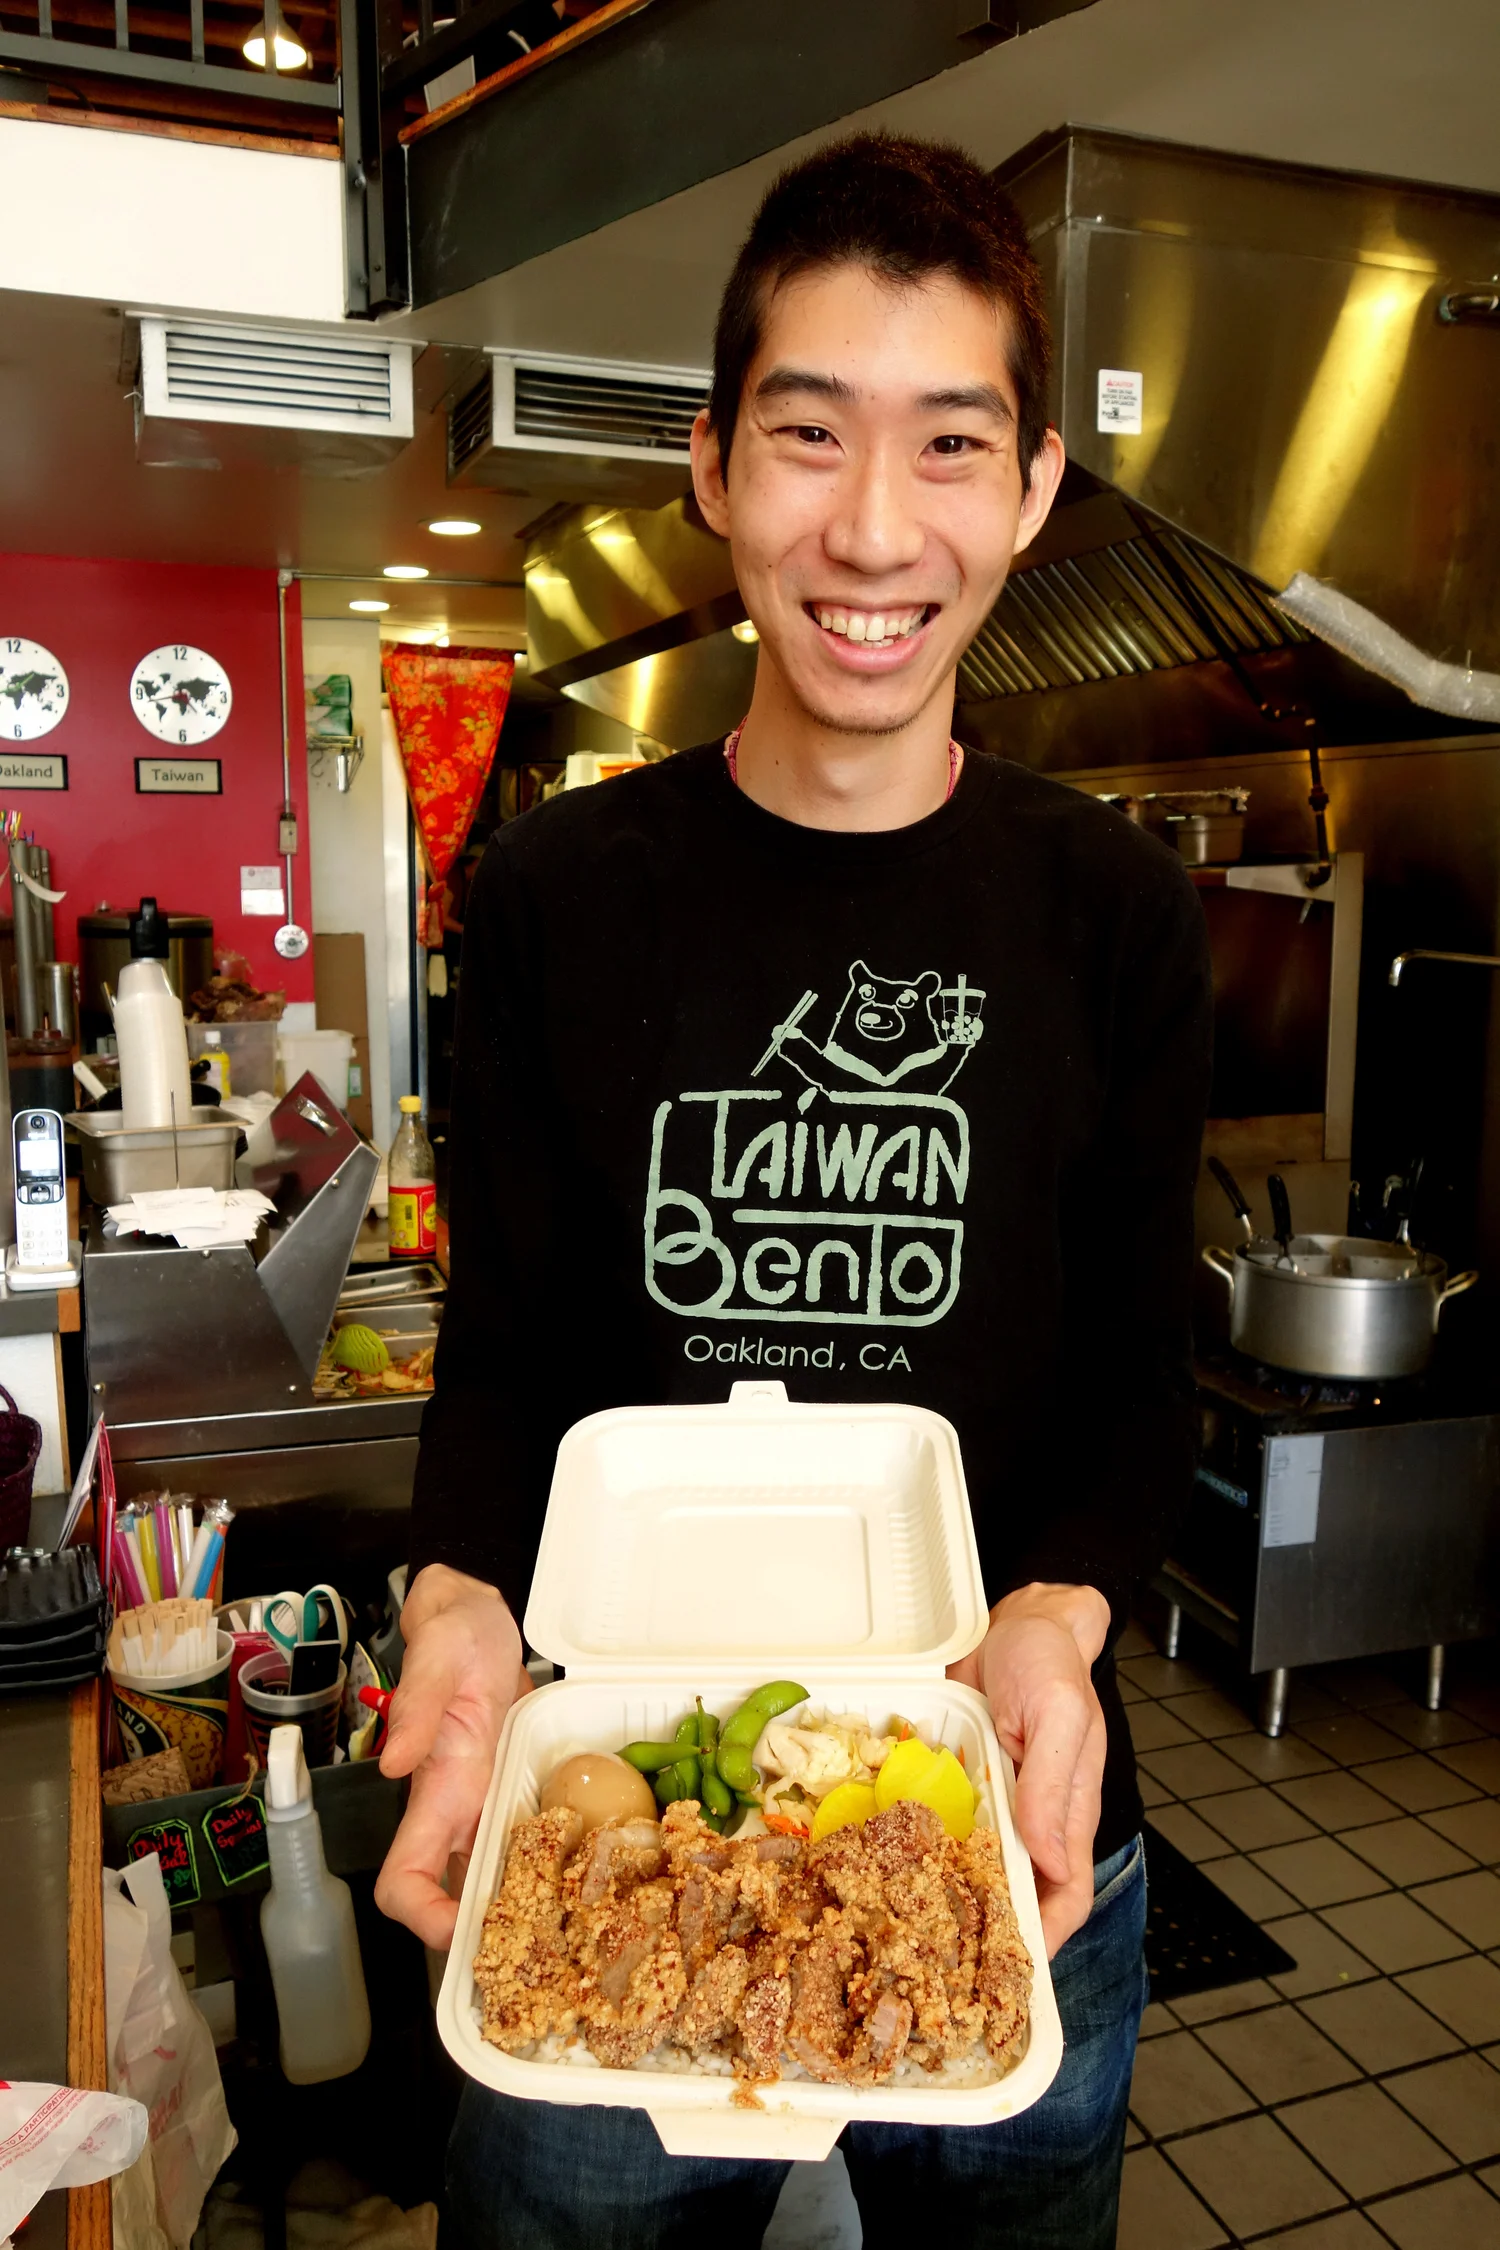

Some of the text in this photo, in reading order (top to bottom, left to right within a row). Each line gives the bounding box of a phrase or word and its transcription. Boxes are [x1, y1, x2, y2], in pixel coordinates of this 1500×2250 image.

[6, 639, 22, 653] 12
[172, 647, 187, 661] 12
[56, 684, 65, 698] 3
[135, 687, 144, 701] 9
[219, 691, 228, 704] 3
[13, 724, 23, 738] 6
[178, 729, 187, 743] 6
[152, 768, 204, 782] Taiwan
[683, 1334, 912, 1372] Oakland, CA
[211, 1809, 252, 1833] Daily
[133, 1831, 184, 1858] Daily
